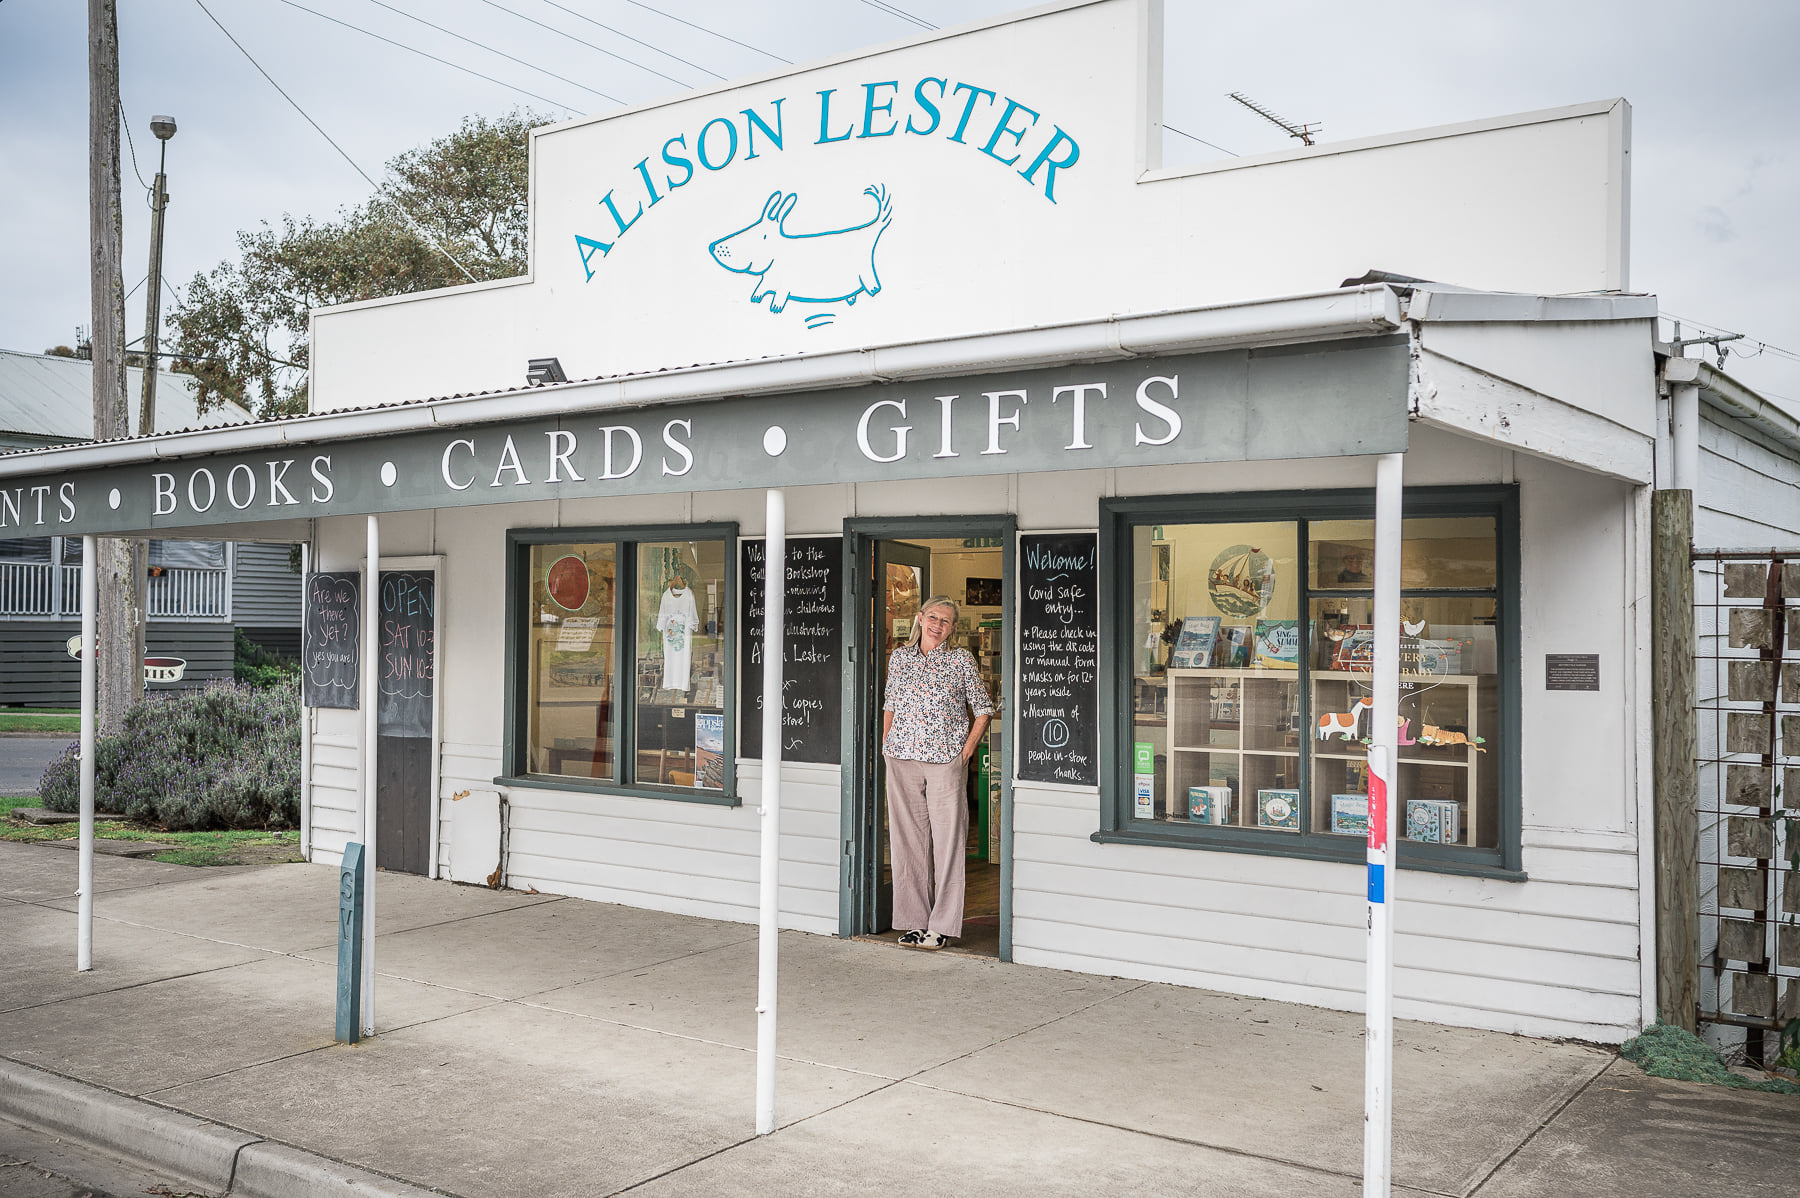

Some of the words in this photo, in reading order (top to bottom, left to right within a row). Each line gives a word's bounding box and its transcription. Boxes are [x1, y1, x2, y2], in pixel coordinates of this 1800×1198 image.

[574, 97, 786, 283] ALISON
[813, 77, 1081, 205] LESTER
[151, 455, 334, 516] BOOKS
[441, 418, 694, 491] CARDS
[856, 374, 1183, 464] GIFTS
[792, 546, 803, 561] to
[806, 546, 827, 561] the
[1026, 544, 1095, 570] Welcome!
[786, 565, 830, 583] Bookshop
[313, 581, 332, 604] Are
[335, 589, 351, 604] we
[383, 578, 434, 618] OPEN
[1029, 585, 1053, 600] Covid
[319, 605, 346, 622] there
[383, 620, 412, 649] SAT
[1031, 625, 1058, 639] Please
[1060, 625, 1084, 639] check
[1085, 625, 1097, 638] in
[1022, 641, 1046, 657] using
[1047, 640, 1064, 651] the
[1078, 641, 1096, 652] code
[1277, 638, 1298, 647] SUMM
[325, 651, 339, 669] you
[793, 643, 831, 664] Lester
[1025, 656, 1034, 665] or
[1037, 656, 1071, 667] manual
[1074, 655, 1096, 669] form
[384, 653, 412, 680] SUN
[1028, 671, 1053, 683] Masks
[1054, 673, 1066, 683] on
[1067, 670, 1080, 685] for
[1024, 687, 1047, 702] years
[1049, 685, 1072, 697] inside
[792, 698, 823, 717] copies
[1028, 703, 1065, 719] Maximum
[1070, 704, 1080, 722] of
[1048, 722, 1063, 742] 10
[1028, 749, 1052, 766] people
